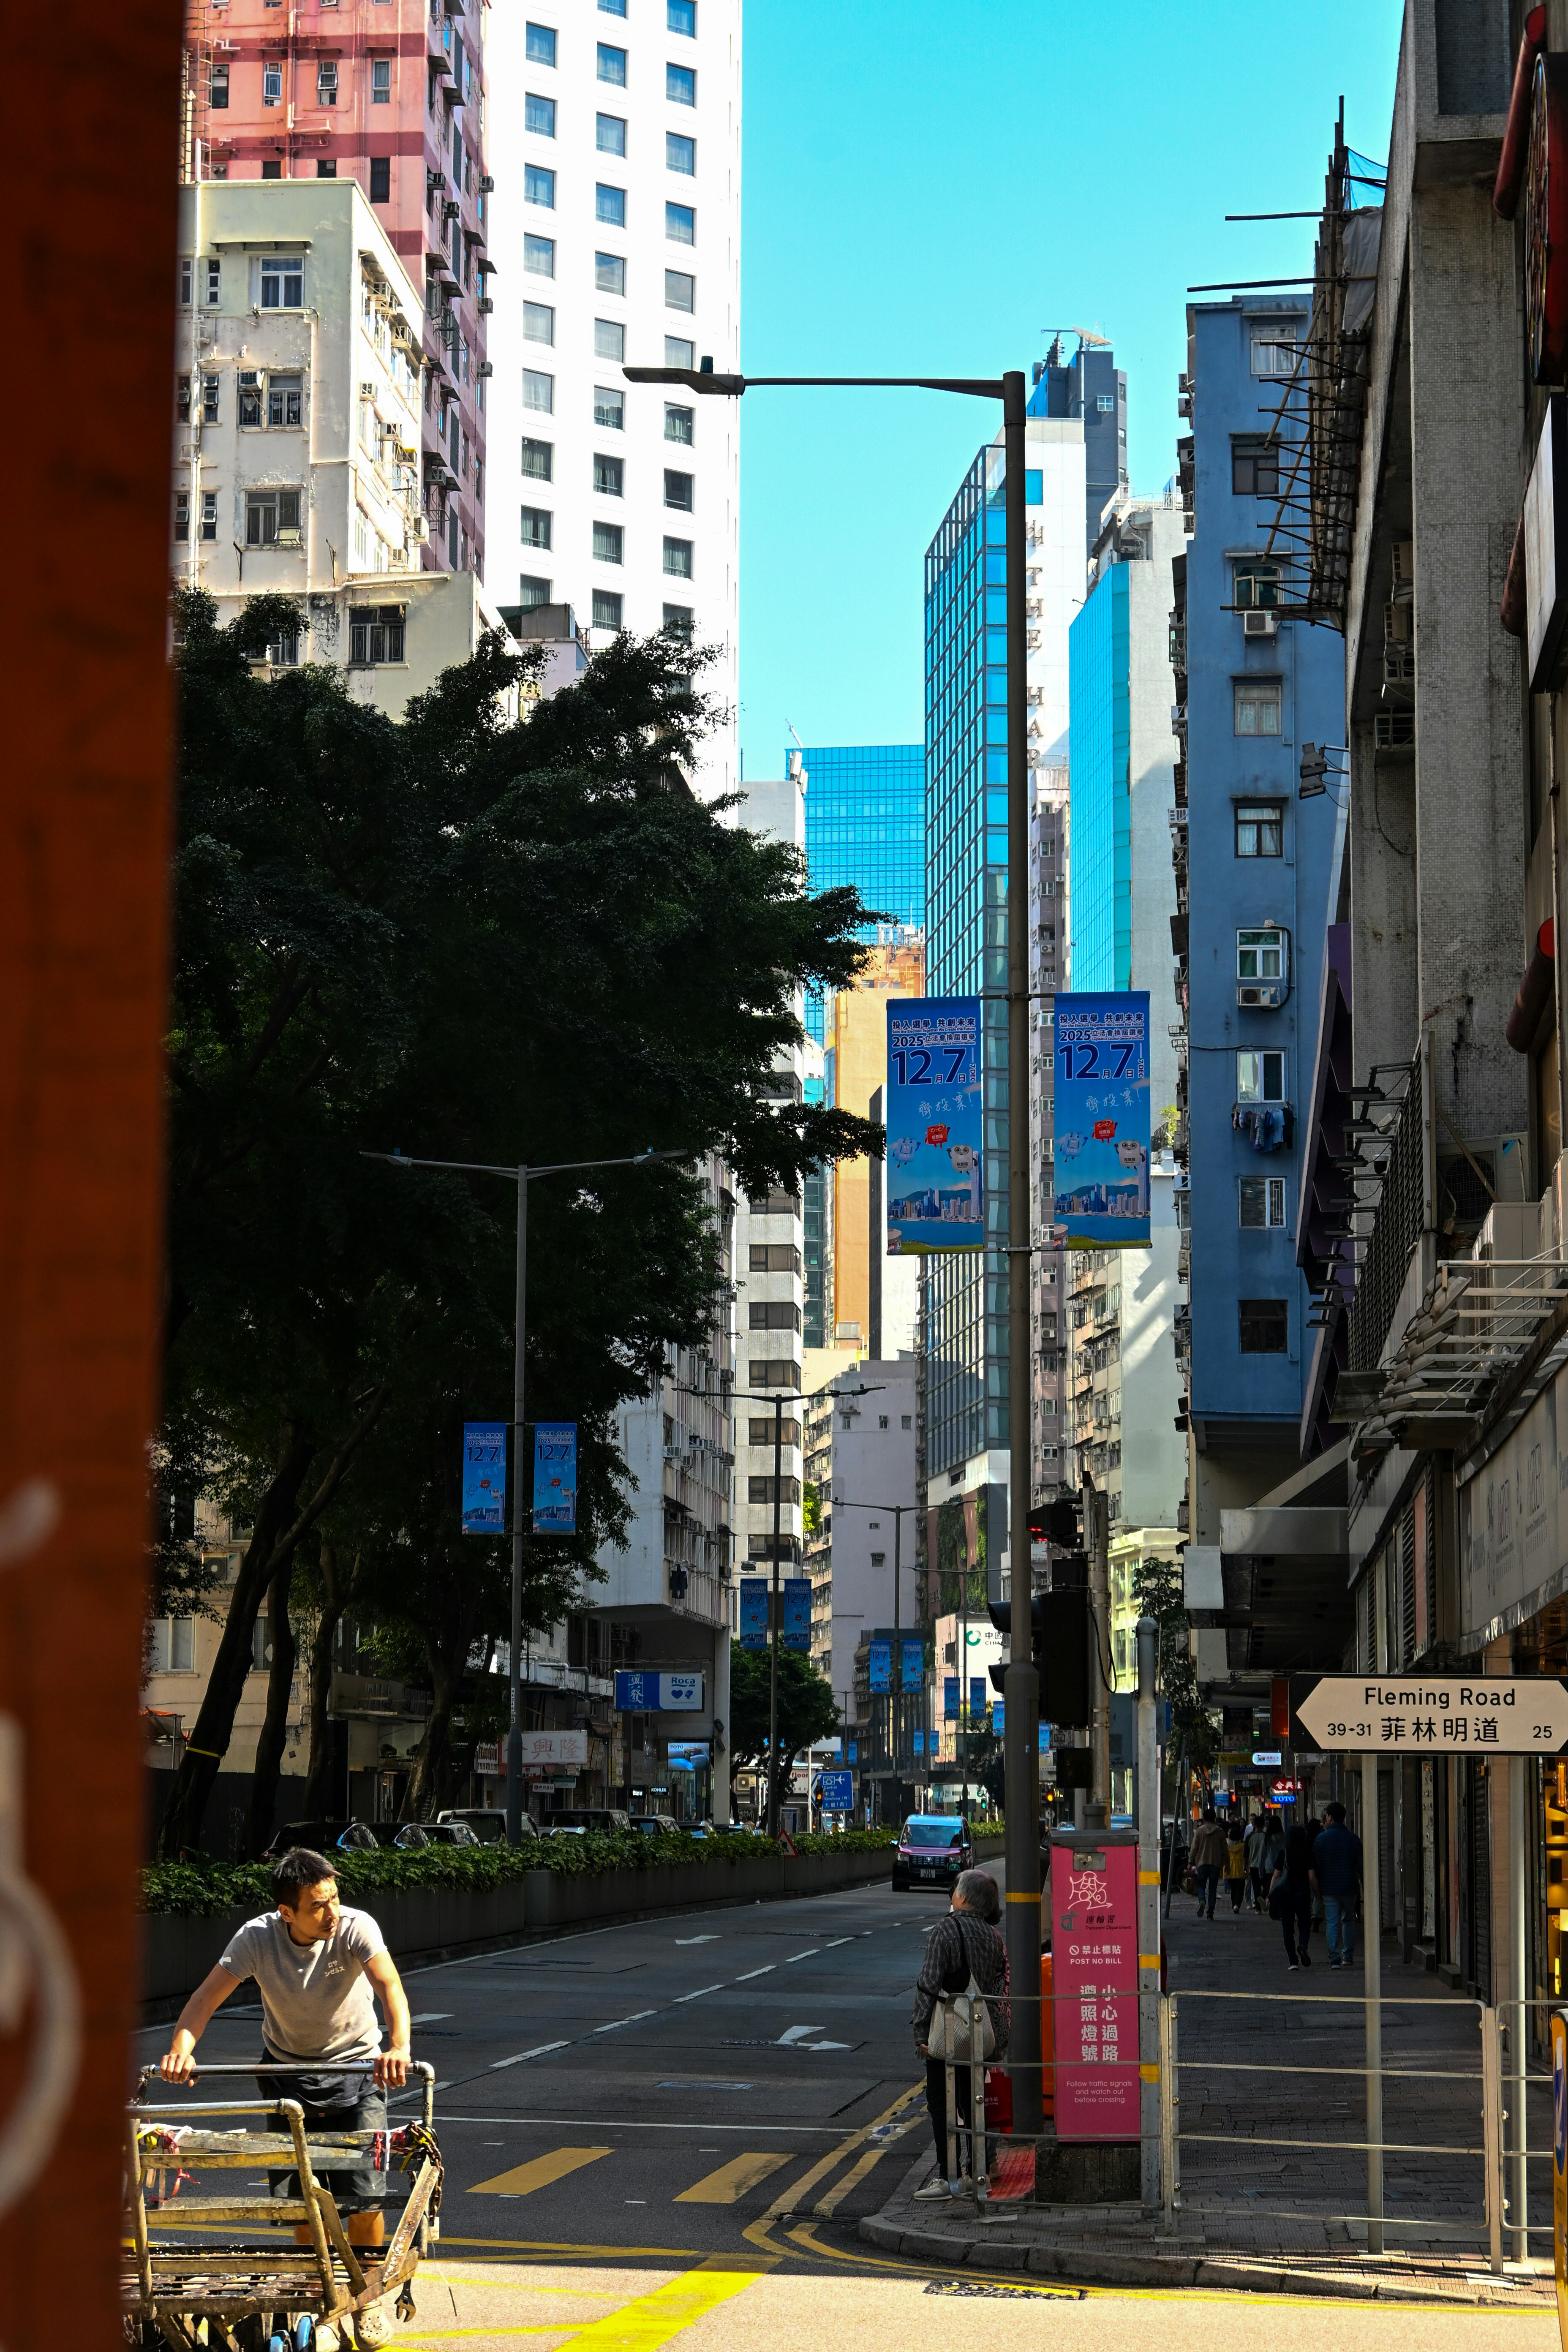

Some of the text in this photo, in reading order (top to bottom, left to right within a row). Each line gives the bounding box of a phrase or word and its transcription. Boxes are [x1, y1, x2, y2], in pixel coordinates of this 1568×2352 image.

[1026, 567, 1043, 648] THE
[892, 1017, 976, 1029] 投入選舉 共創未來
[1059, 1012, 1144, 1024] 投入選舉 共創未來
[892, 1035, 924, 1048] 2025
[1059, 1029, 1091, 1042] 2025
[1365, 1688, 1515, 1709] Fleming Road
[1381, 1717, 1499, 1742] 菲林明道
[1533, 1726, 1553, 1739] 25
[1086, 1915, 1115, 1924] 運輸署
[1082, 1945, 1121, 1955] 禁止標貼
[1080, 1984, 1098, 2061] 遵照燈號
[1101, 1984, 1119, 2061] 小心過路
